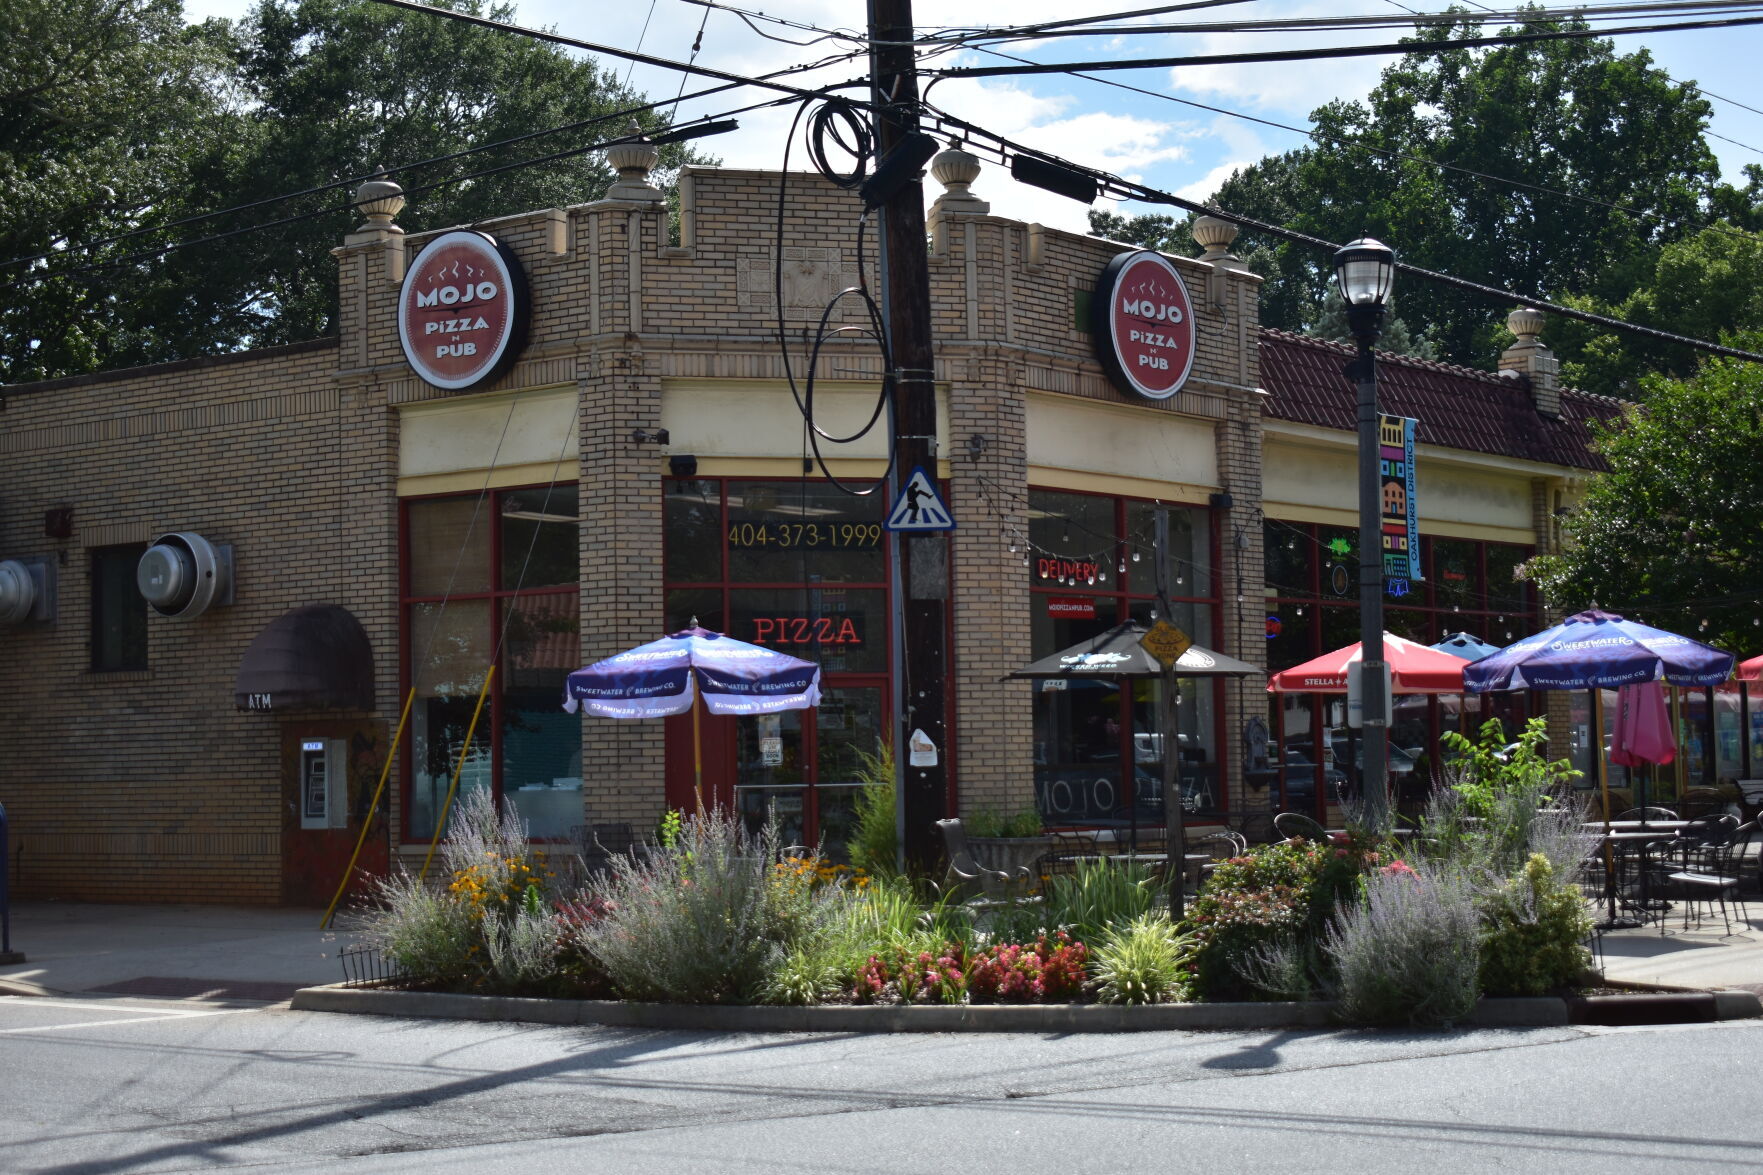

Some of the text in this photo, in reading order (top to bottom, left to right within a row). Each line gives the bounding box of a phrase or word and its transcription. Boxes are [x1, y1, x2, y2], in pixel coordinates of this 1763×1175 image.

[417, 281, 497, 308] MOJO
[1123, 297, 1183, 324] MOJO
[436, 342, 477, 358] PUB
[1139, 354, 1169, 370] PUB
[1407, 438, 1415, 492] DISTRICT
[728, 523, 881, 547] 404-373-1999
[1039, 558, 1099, 583] DELIVERY
[753, 618, 861, 643] PIZZA
[761, 682, 795, 690] BREWING
[1304, 678, 1333, 686] STELLA
[1533, 678, 1584, 686] SWEETWATER
[1597, 673, 1632, 684] BREWING
[576, 685, 623, 696] SWEETWATER
[635, 685, 662, 695] BREWING
[248, 693, 271, 709] ATM
[1036, 778, 1114, 814] MOJO
